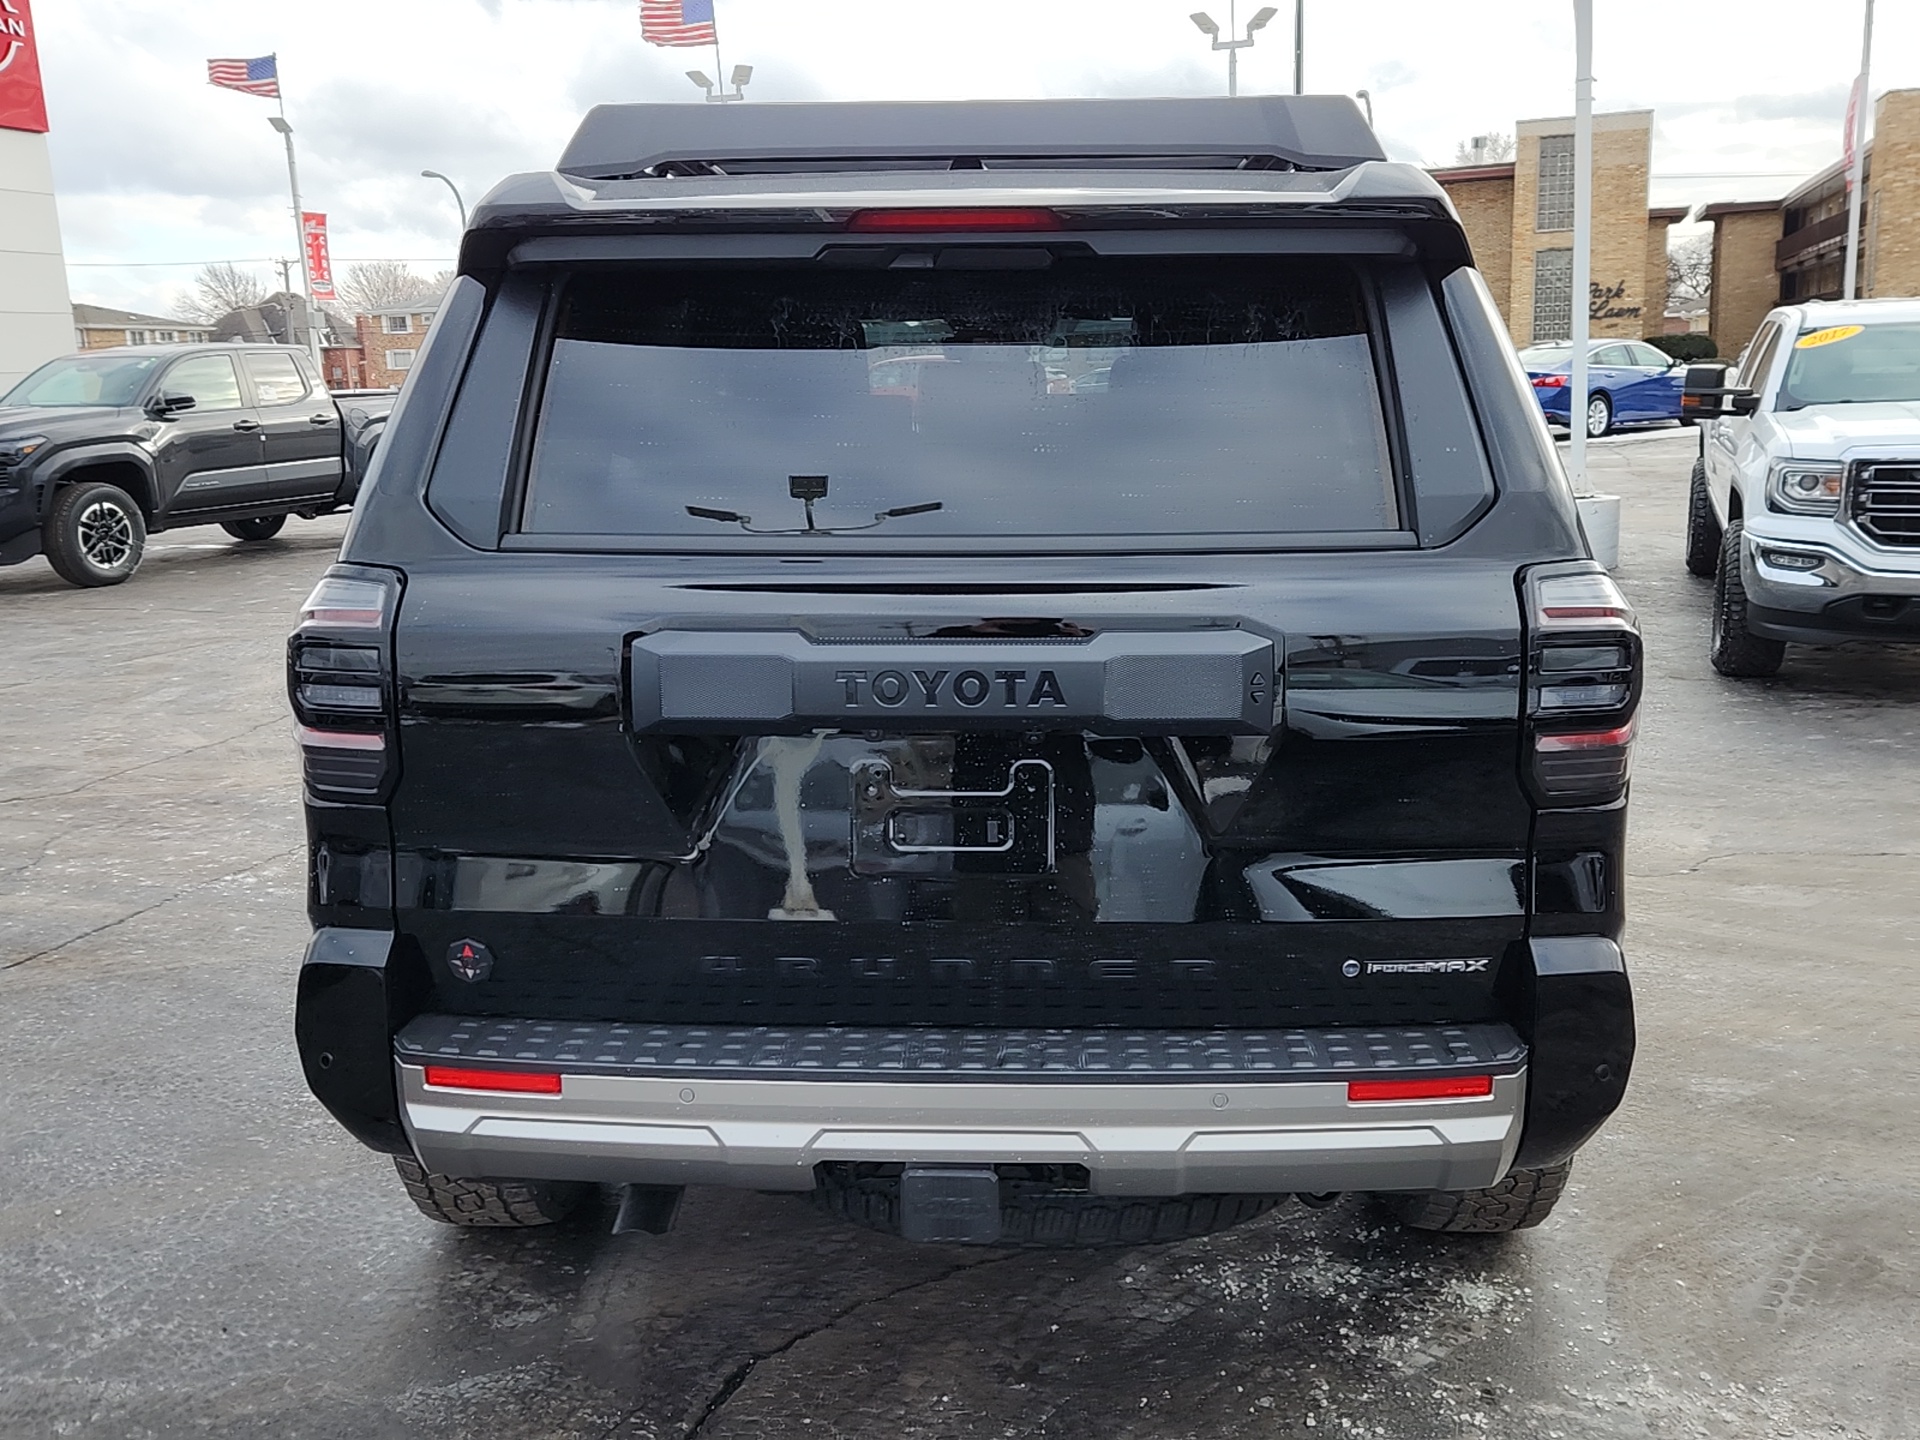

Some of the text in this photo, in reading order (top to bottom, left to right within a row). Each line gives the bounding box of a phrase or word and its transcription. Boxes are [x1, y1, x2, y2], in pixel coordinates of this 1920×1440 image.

[319, 235, 330, 279] CARS
[1807, 326, 1850, 346] 2017
[835, 669, 1068, 708] TOYOTA
